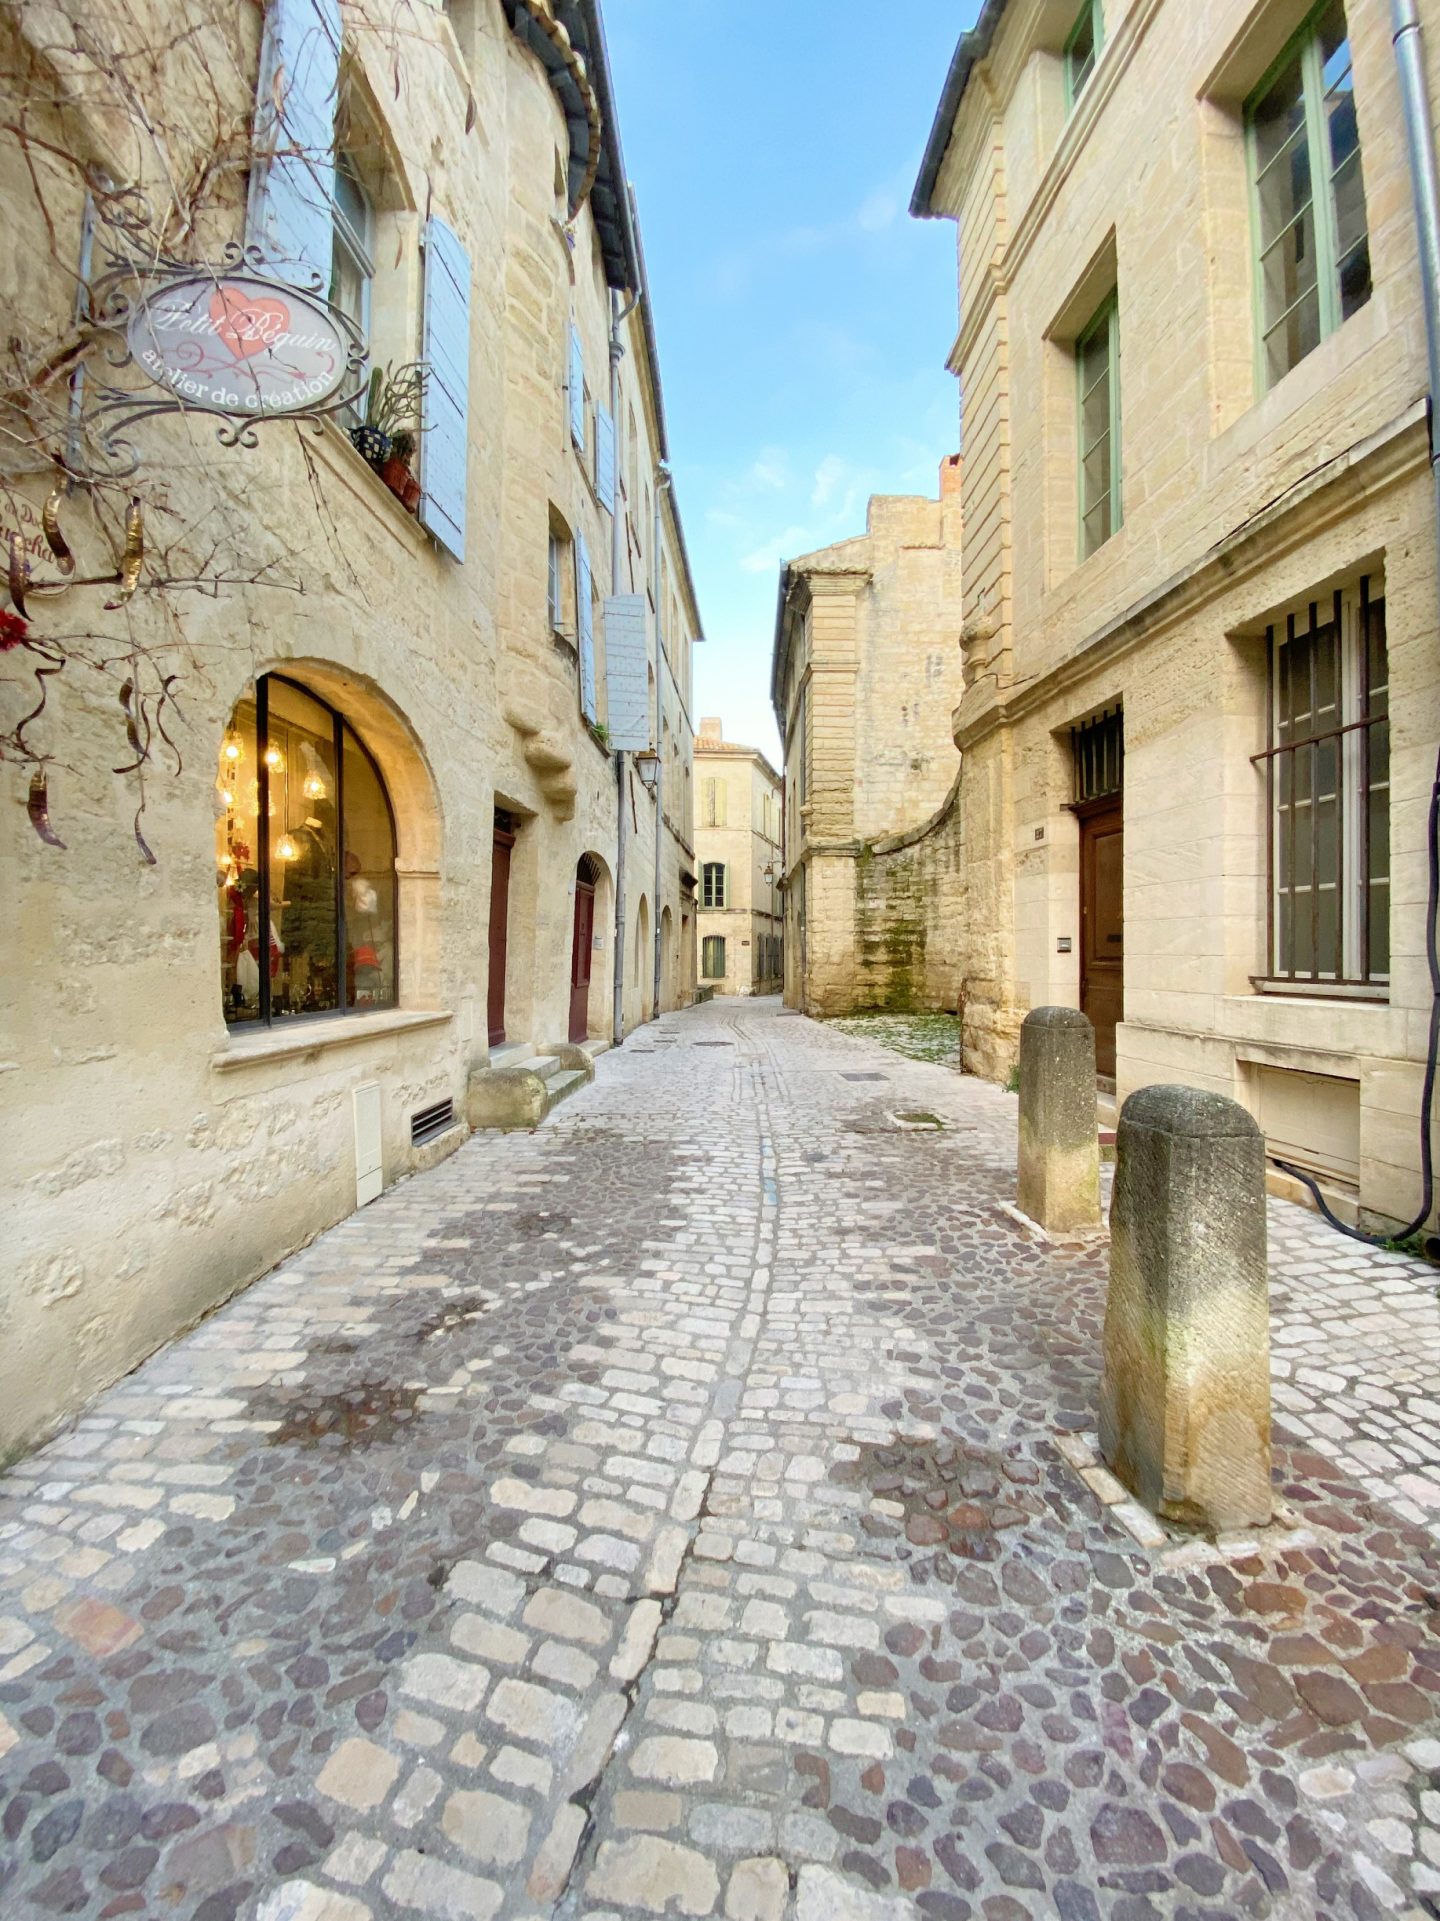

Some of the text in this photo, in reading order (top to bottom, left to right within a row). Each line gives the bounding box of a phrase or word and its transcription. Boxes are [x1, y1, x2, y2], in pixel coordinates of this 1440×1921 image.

[154, 301, 337, 354] Petit Béguin
[210, 387, 239, 407] de
